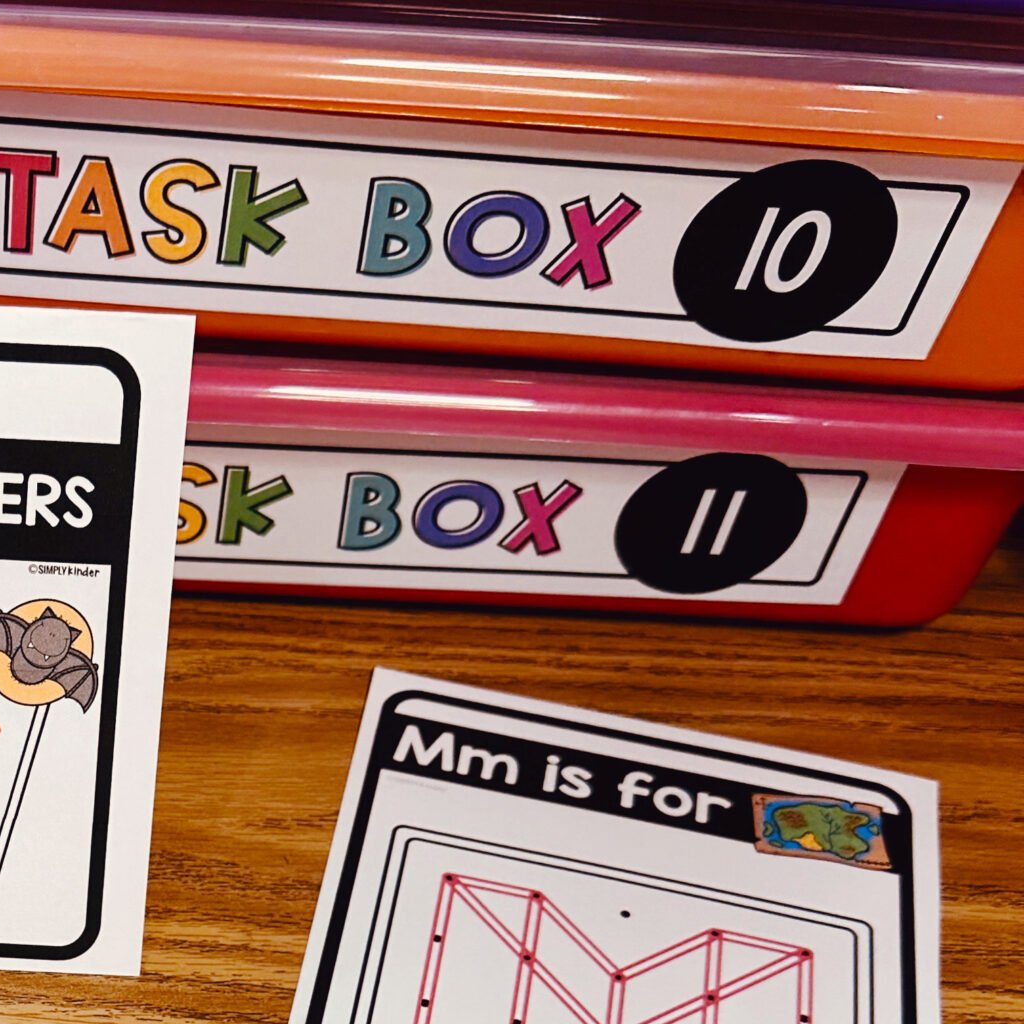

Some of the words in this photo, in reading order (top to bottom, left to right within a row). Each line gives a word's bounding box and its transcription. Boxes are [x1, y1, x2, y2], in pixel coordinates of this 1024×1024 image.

[356, 176, 642, 292] BOX
[734, 206, 832, 293] 10
[337, 471, 583, 557] BOX
[680, 488, 747, 556] 11
[393, 724, 519, 785] Mm
[542, 754, 594, 799] is
[617, 771, 732, 824] for
